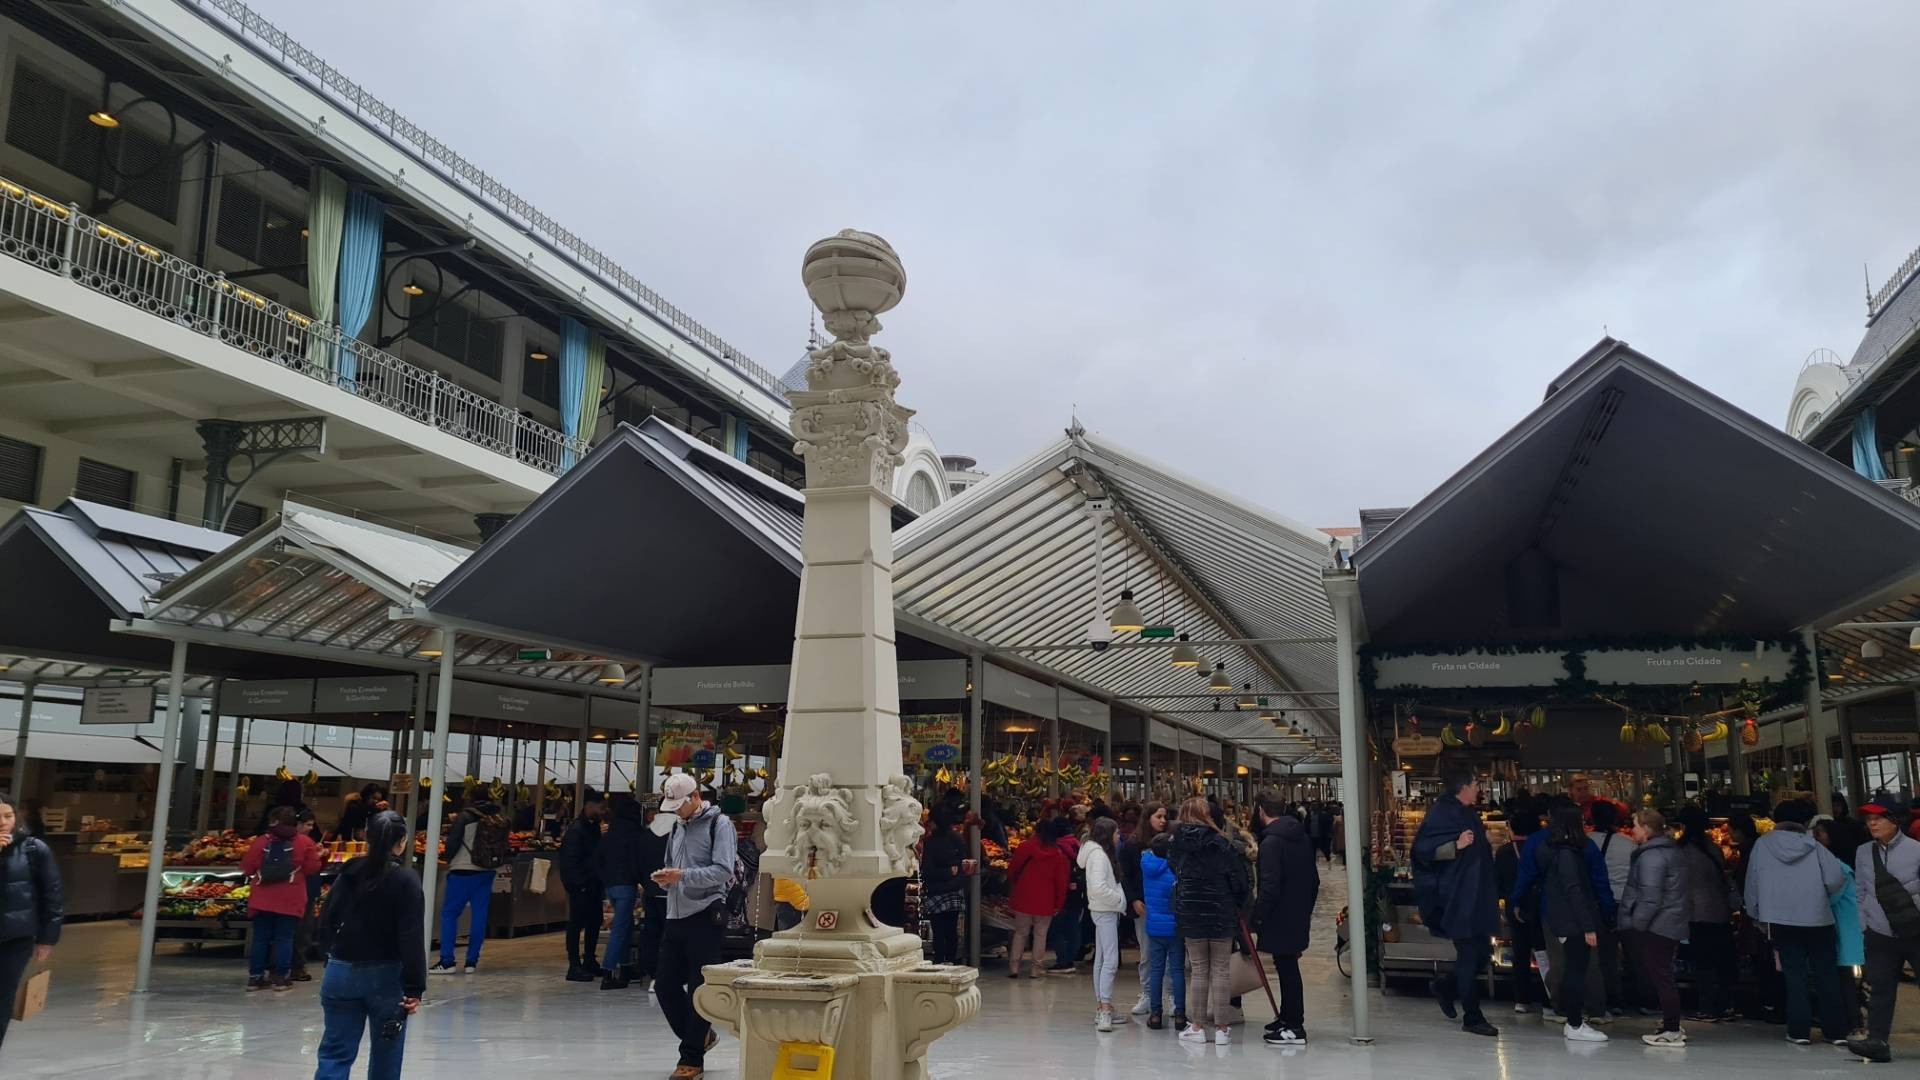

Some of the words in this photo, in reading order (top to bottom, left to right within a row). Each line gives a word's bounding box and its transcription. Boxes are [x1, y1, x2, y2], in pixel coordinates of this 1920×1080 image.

[1431, 662, 1455, 671] Fruta
[1468, 661, 1500, 670] Cidade
[1647, 656, 1672, 666] Fruta
[1673, 658, 1685, 666] na
[1687, 656, 1722, 666] Cidade
[697, 681, 722, 689] Frutaria
